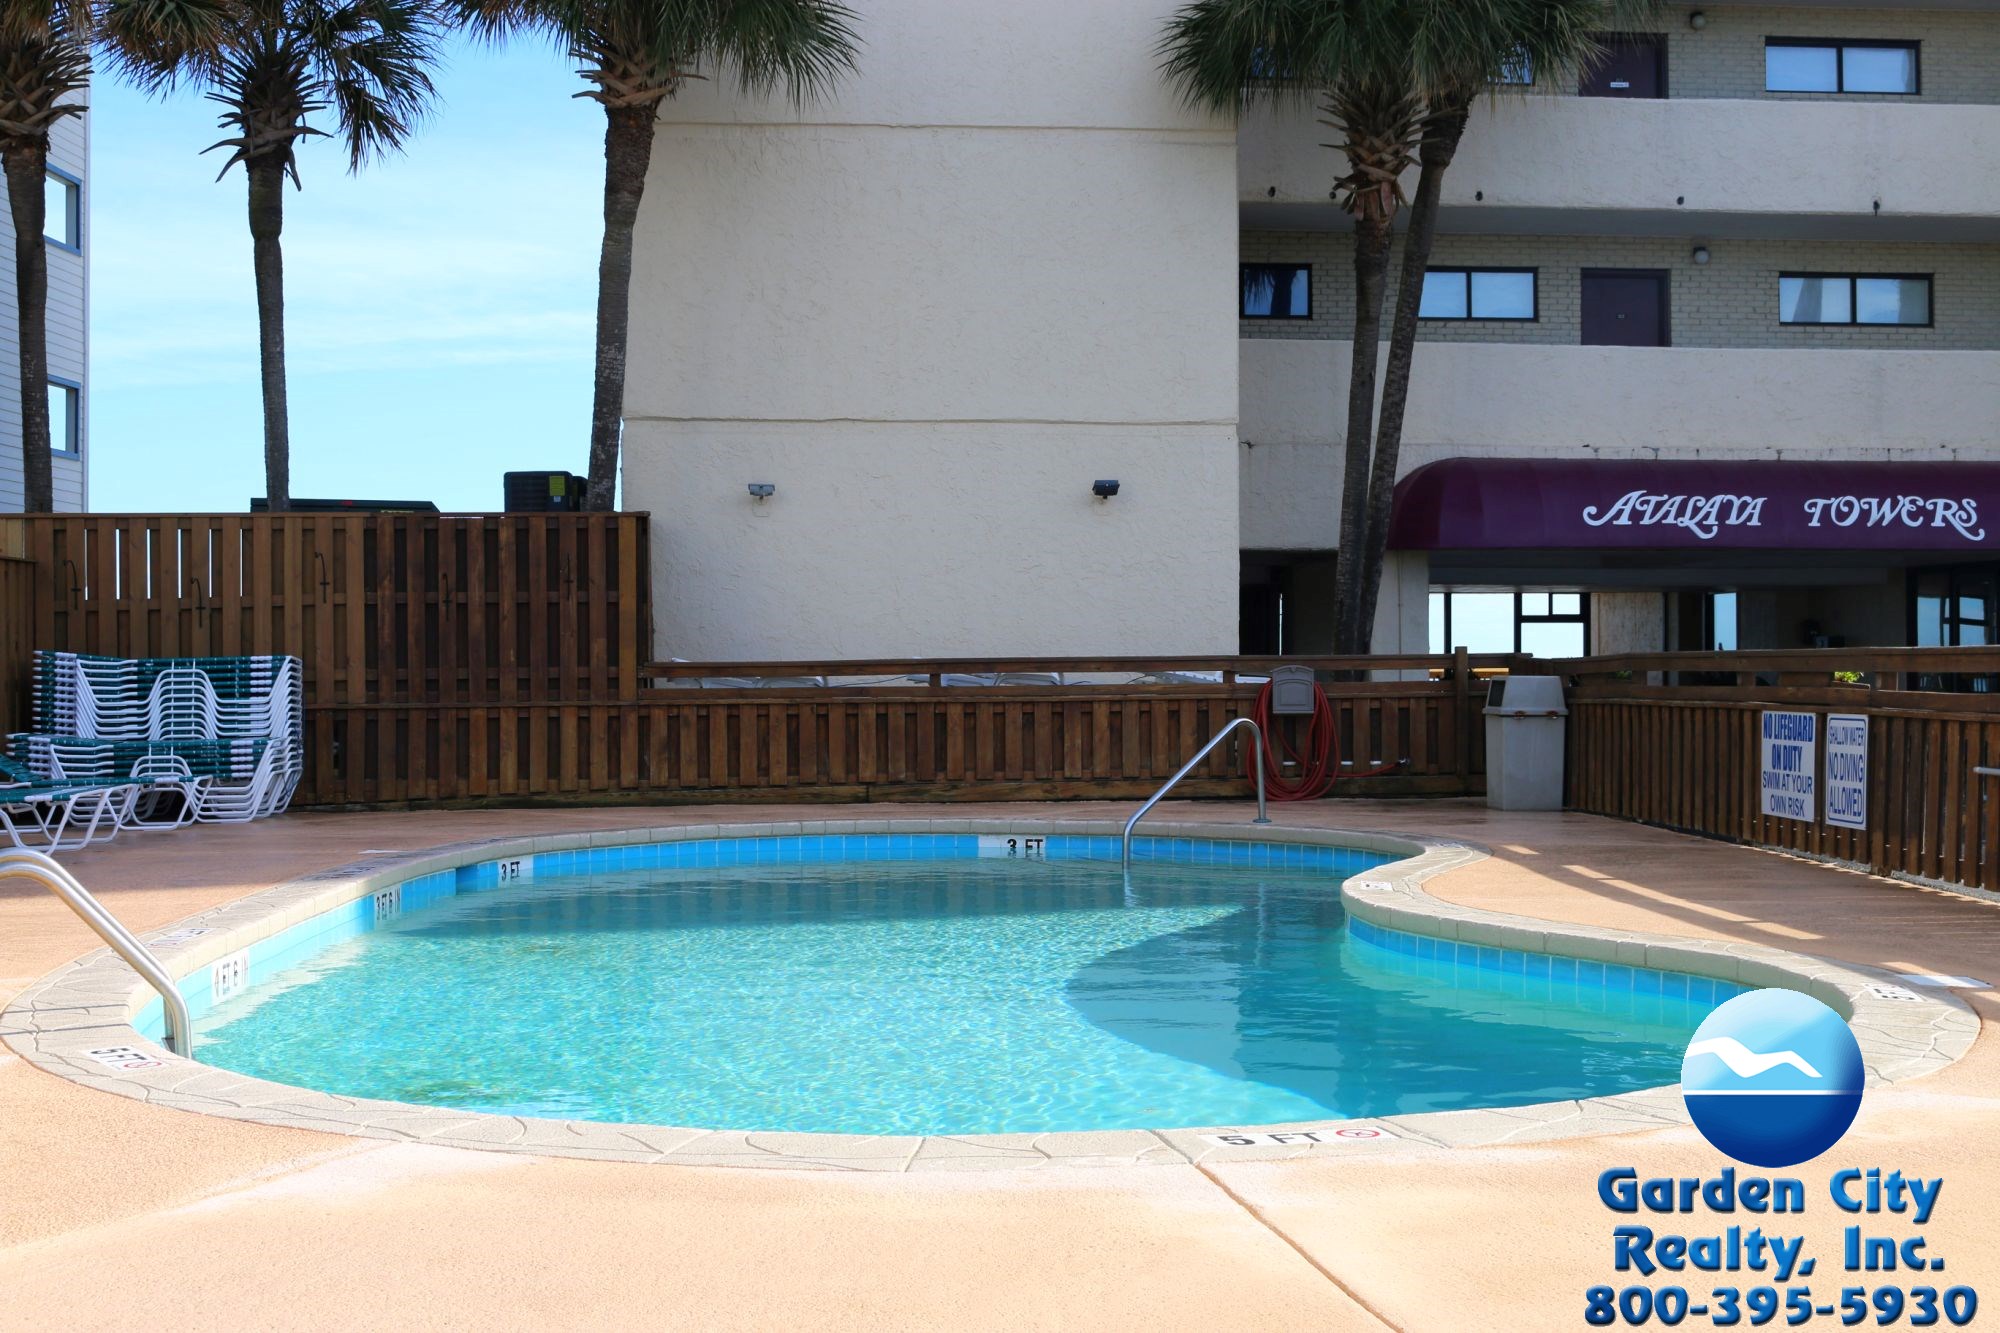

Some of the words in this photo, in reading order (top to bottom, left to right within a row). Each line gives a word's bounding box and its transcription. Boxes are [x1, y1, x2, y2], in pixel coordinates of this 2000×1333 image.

[1583, 490, 1768, 539] ATALAYA
[1804, 495, 1985, 541] TOWERS
[1763, 712, 1773, 740] NO
[1774, 713, 1814, 743] LIFEGUARD
[1849, 726, 1864, 747] WATER
[1771, 743, 1782, 771] ON
[1783, 744, 1803, 773] DUTY
[1828, 751, 1839, 781] NO
[1840, 752, 1864, 783] DIVING
[1762, 770, 1780, 790] SWIM
[1782, 773, 1791, 791] AT
[1792, 774, 1813, 795] YOUR
[1770, 793, 1787, 814] OWN
[1788, 796, 1805, 818] RISK
[1829, 786, 1863, 817] ALLOWED
[1007, 838, 1017, 857] 3
[1025, 838, 1043, 857] FT
[501, 863, 507, 880] 3
[510, 860, 520, 879] FT
[1218, 1135, 1256, 1146] 5
[1267, 1132, 1322, 1144] FT
